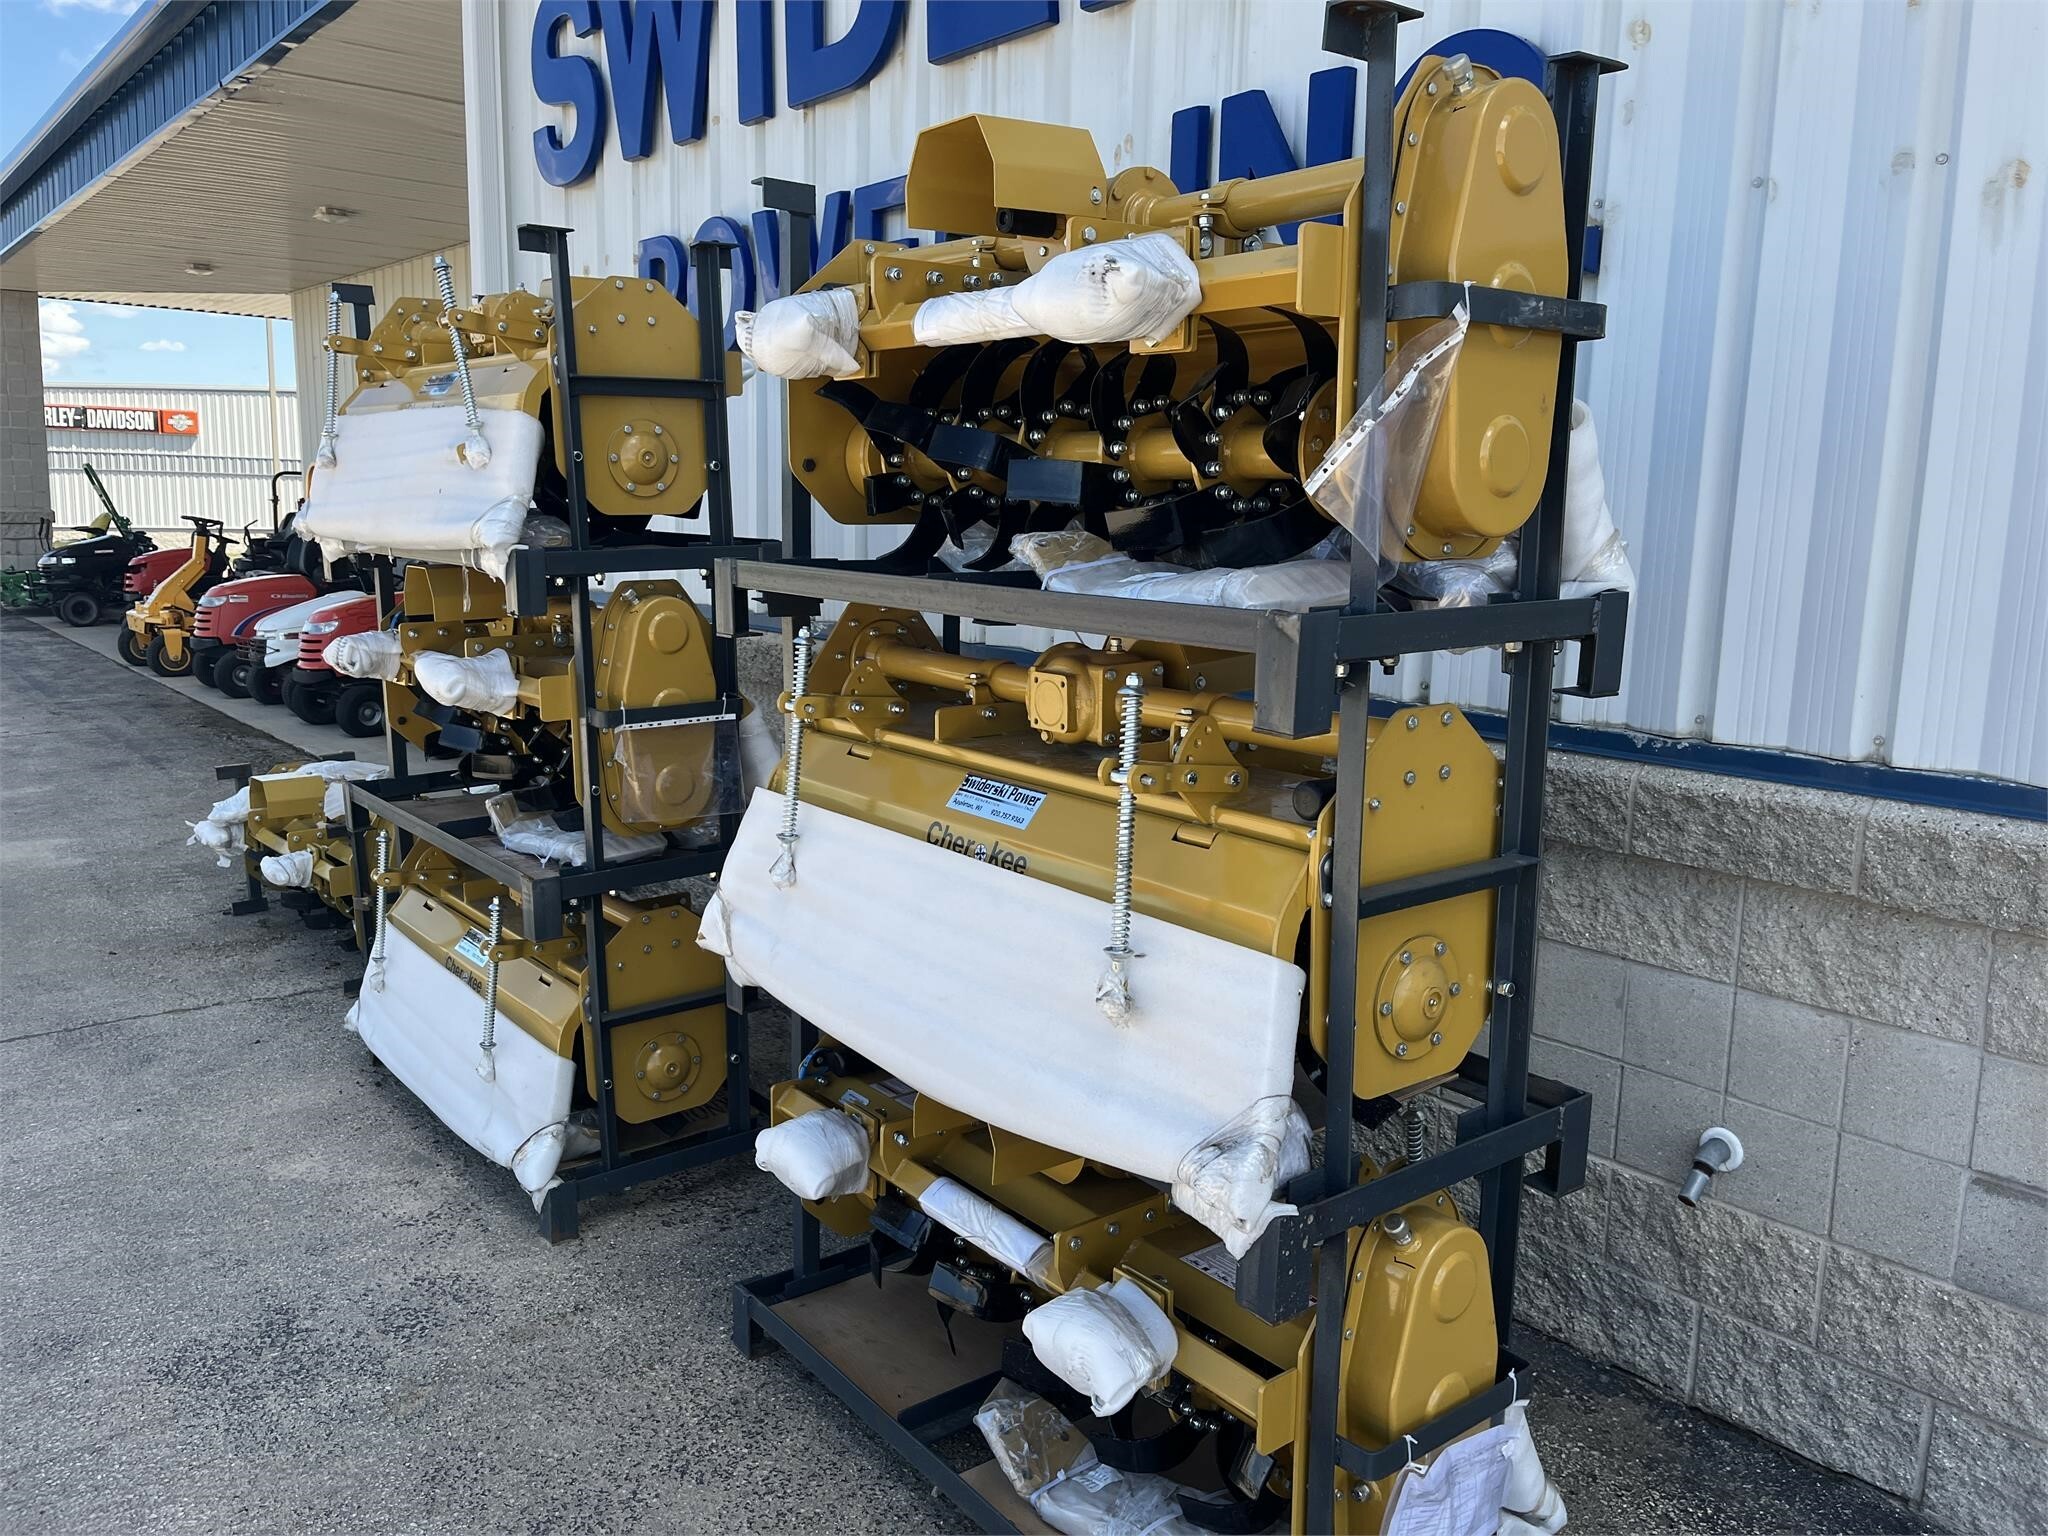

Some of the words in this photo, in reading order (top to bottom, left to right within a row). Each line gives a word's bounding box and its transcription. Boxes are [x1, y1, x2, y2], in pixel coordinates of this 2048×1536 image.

[531, 0, 1130, 187] SWID
[638, 174, 974, 352] POWE
[1007, 787, 1042, 807] Power
